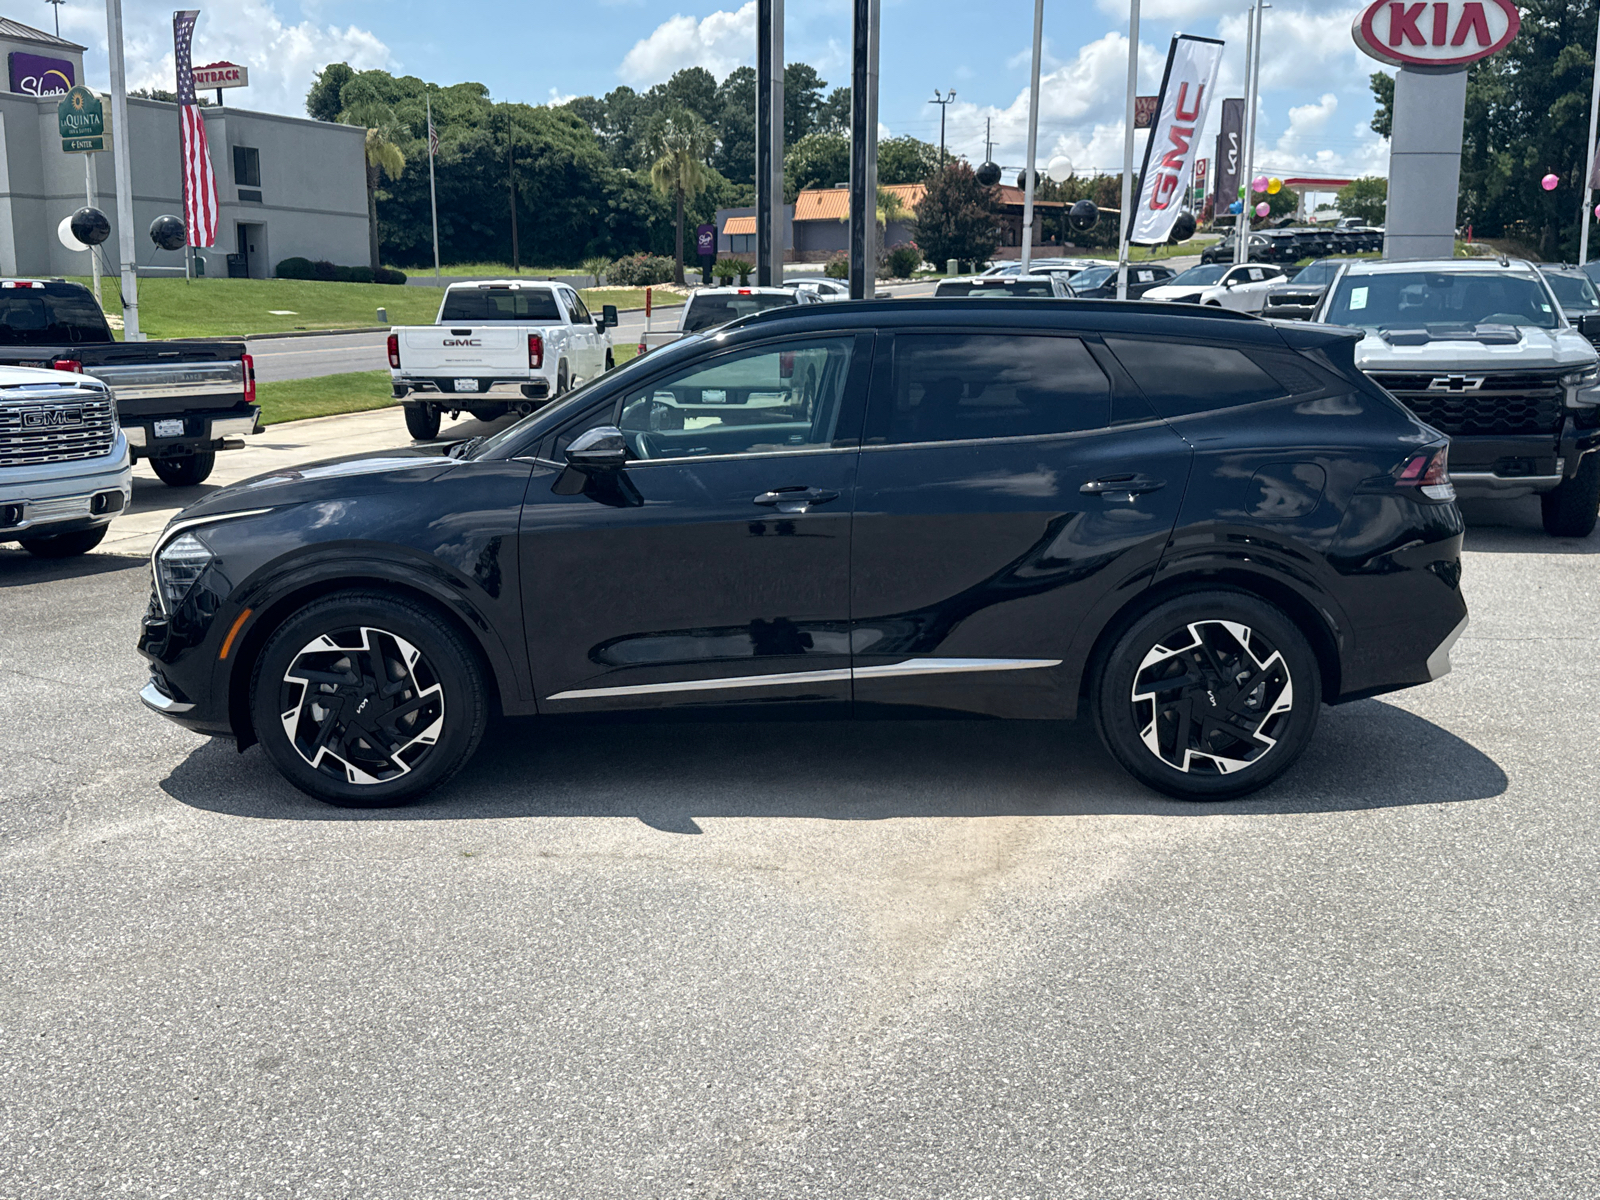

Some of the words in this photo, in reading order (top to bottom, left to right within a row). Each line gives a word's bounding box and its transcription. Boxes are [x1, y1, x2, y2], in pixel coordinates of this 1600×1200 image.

[1388, 2, 1493, 46] KIA
[66, 113, 101, 129] QUINTA
[76, 140, 93, 149] ENTER
[1149, 81, 1206, 211] GMC
[24, 409, 81, 427] GMC
